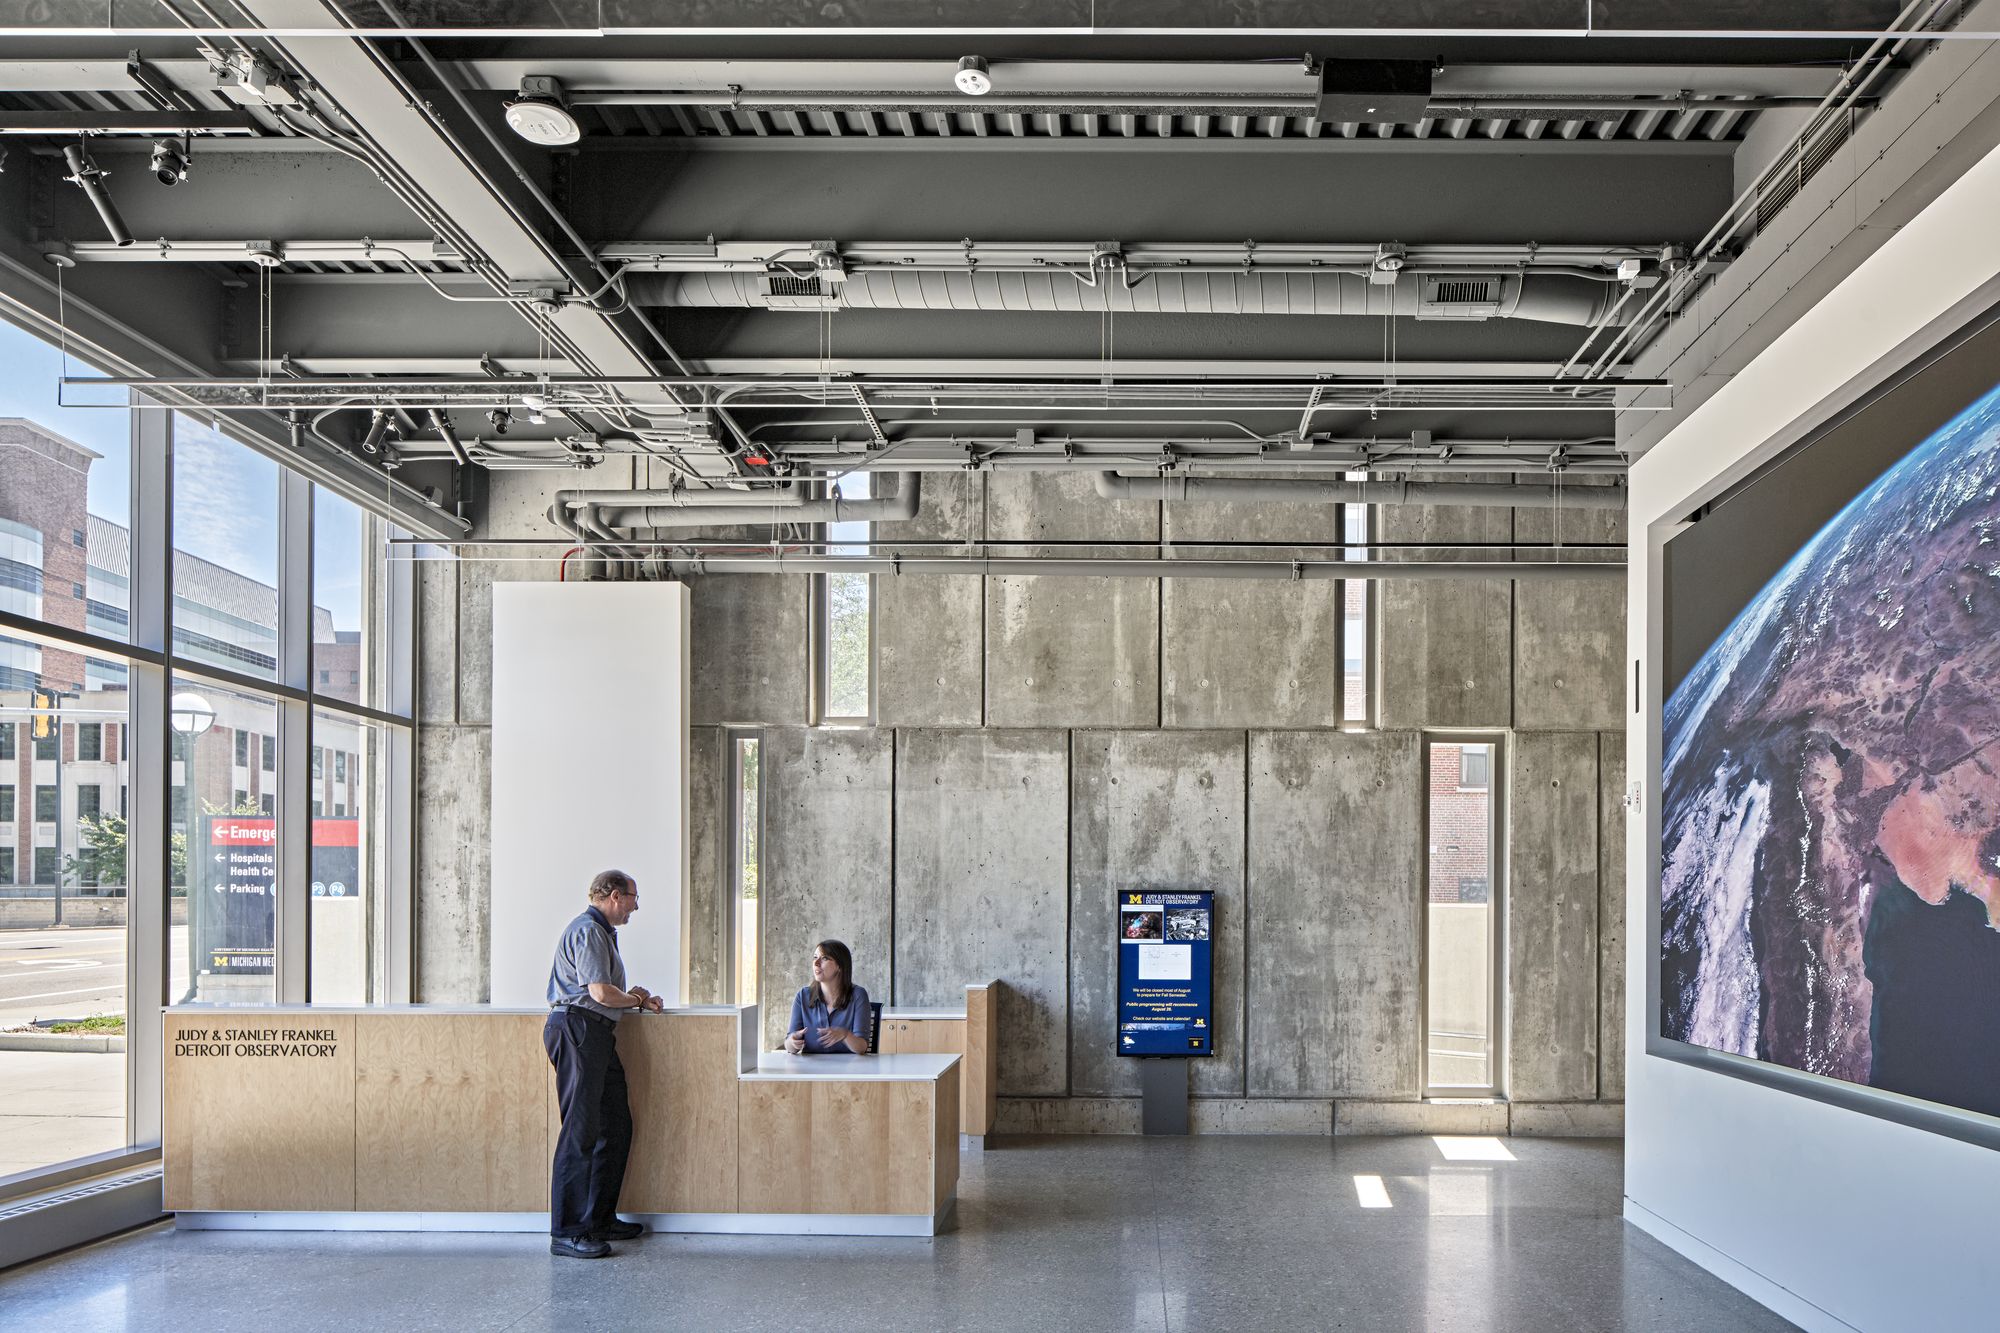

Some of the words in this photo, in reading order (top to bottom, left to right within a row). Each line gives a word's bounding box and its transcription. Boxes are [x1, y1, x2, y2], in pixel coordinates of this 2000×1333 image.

[230, 825, 276, 842] Emerge
[230, 853, 273, 864] Hospitals
[230, 866, 260, 877] Health
[262, 866, 274, 877] Ce
[230, 883, 265, 895] Parking
[312, 885, 323, 894] P3
[332, 885, 343, 894] P4
[1129, 894, 1142, 904] M
[214, 956, 228, 967] M
[231, 956, 261, 967] MICHIGAN
[175, 1029, 208, 1041] JUDY
[211, 1029, 222, 1041] &
[225, 1029, 278, 1041] STANLEY
[281, 1029, 337, 1041] FRANKEL
[175, 1044, 231, 1057] DETROIT
[234, 1044, 337, 1057] OBSERVATORY
